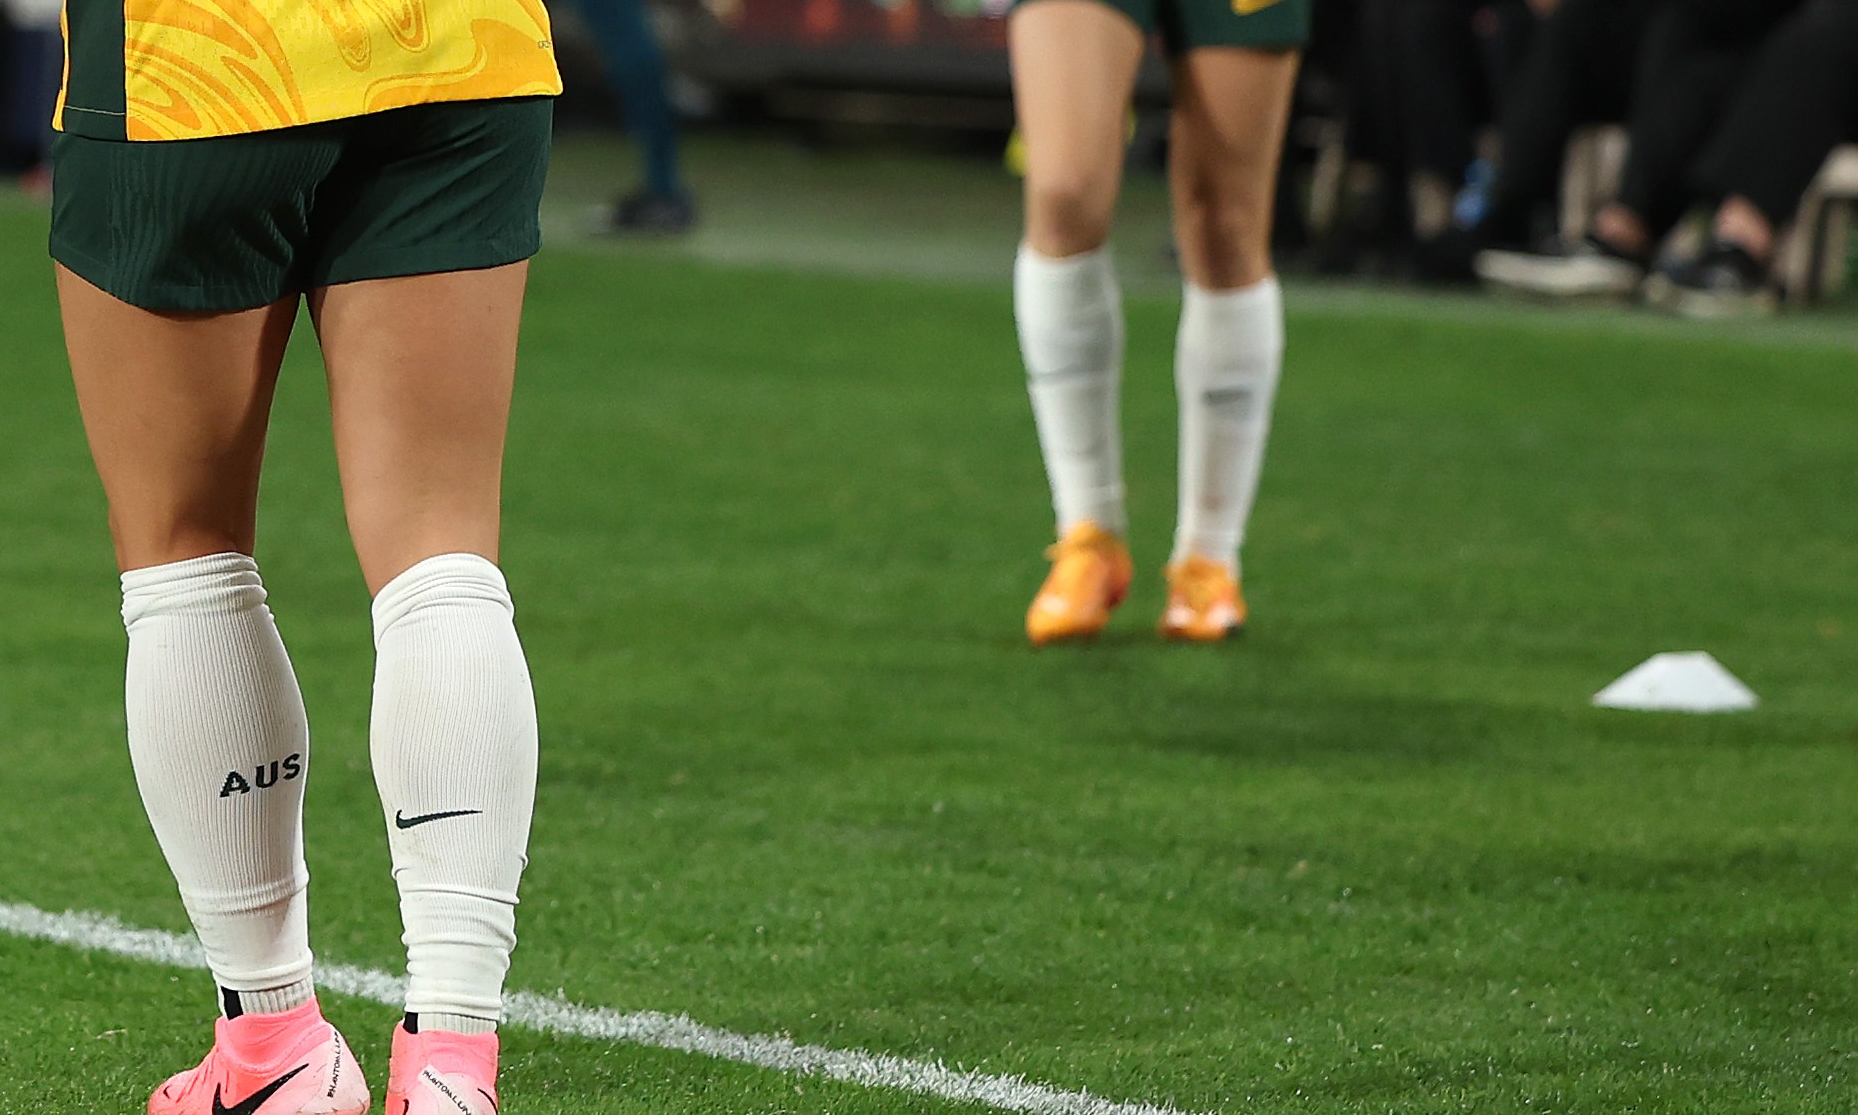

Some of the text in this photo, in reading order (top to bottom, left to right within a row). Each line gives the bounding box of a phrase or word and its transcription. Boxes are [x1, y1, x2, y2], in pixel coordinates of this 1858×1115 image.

[219, 753, 301, 798] AUS
[327, 1054, 341, 1098] PHANTOM
[423, 1070, 453, 1098] PHANTOM
